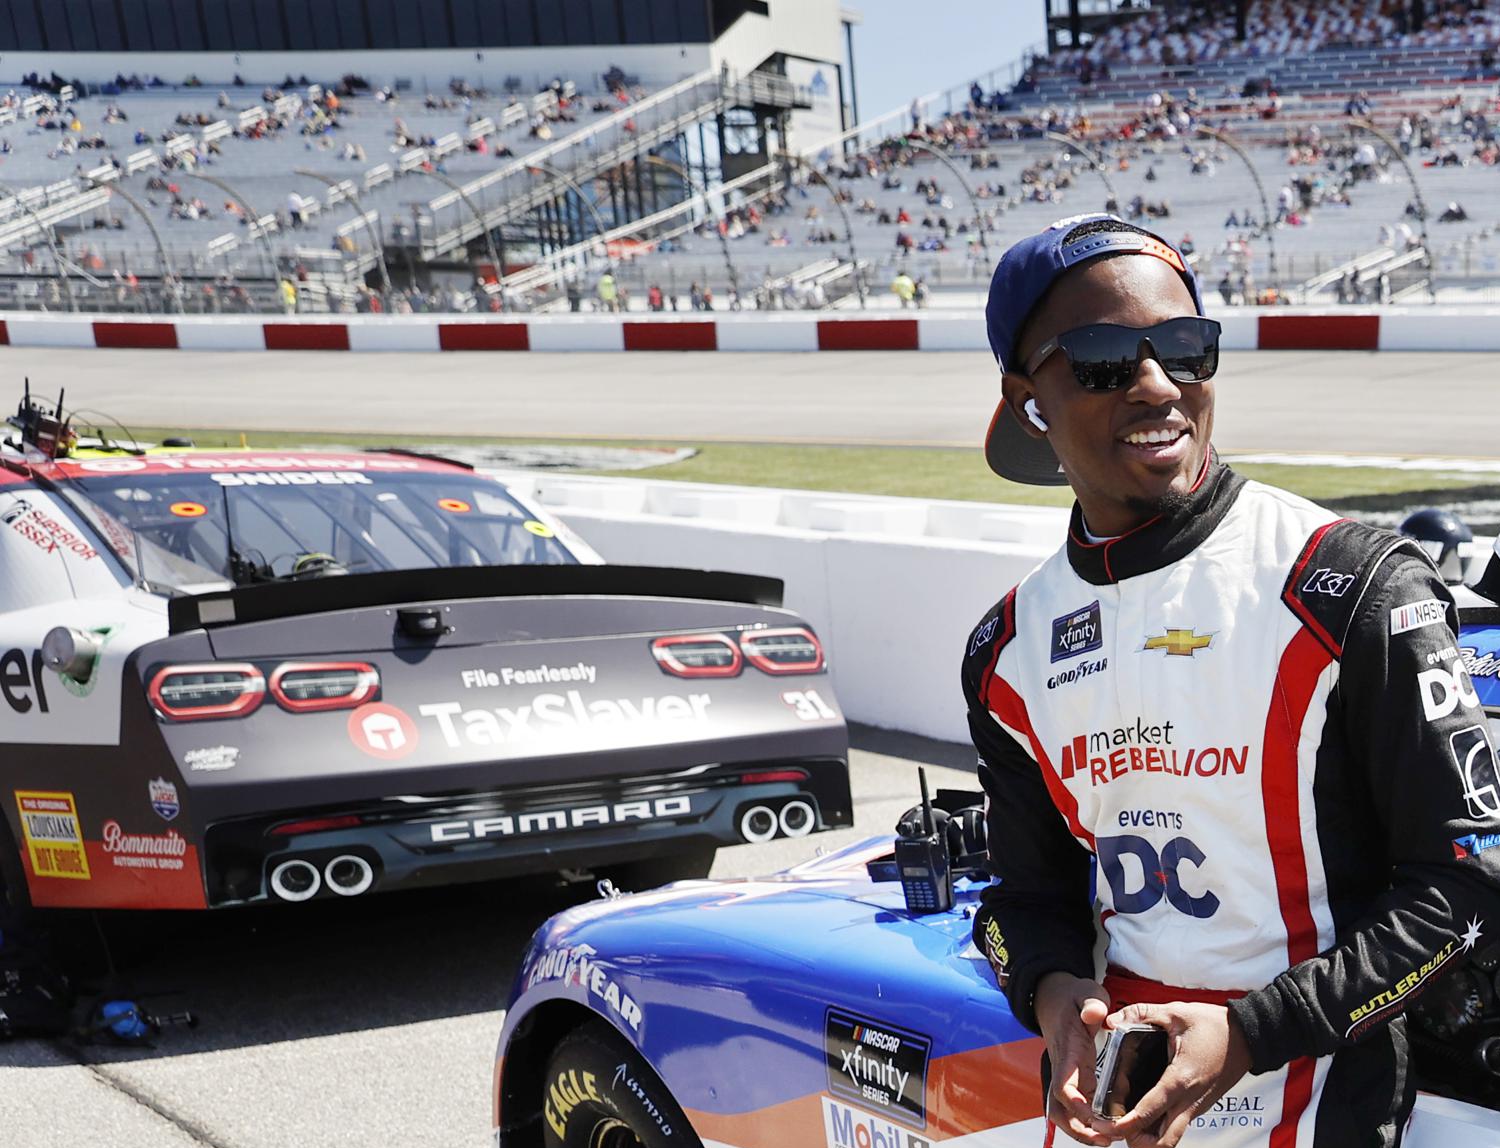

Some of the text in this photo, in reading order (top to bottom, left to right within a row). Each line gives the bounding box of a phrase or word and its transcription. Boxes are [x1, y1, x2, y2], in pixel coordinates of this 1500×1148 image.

[211, 471, 373, 487] SNIDER
[13, 520, 57, 556] ESSEX
[29, 508, 99, 561] SUPERIOR
[1303, 567, 1355, 597] K1
[1059, 622, 1097, 650] xfinity
[462, 662, 597, 688] File Fearlessly
[419, 690, 712, 748] TaxSlayer
[779, 689, 838, 721] 31
[1090, 717, 1174, 754] market
[1090, 745, 1250, 787] REBELLION
[26, 815, 77, 840] LOUISIANA
[431, 795, 691, 843] CAMARO
[1118, 809, 1183, 831] events
[159, 857, 184, 870] GROUP
[1096, 834, 1221, 919] DC
[864, 1027, 901, 1053] NASCAR
[840, 1046, 910, 1102] xfinity
[544, 1069, 603, 1140] EAGLE
[861, 1084, 890, 1106] SERIES
[1213, 1096, 1266, 1113] SEAL
